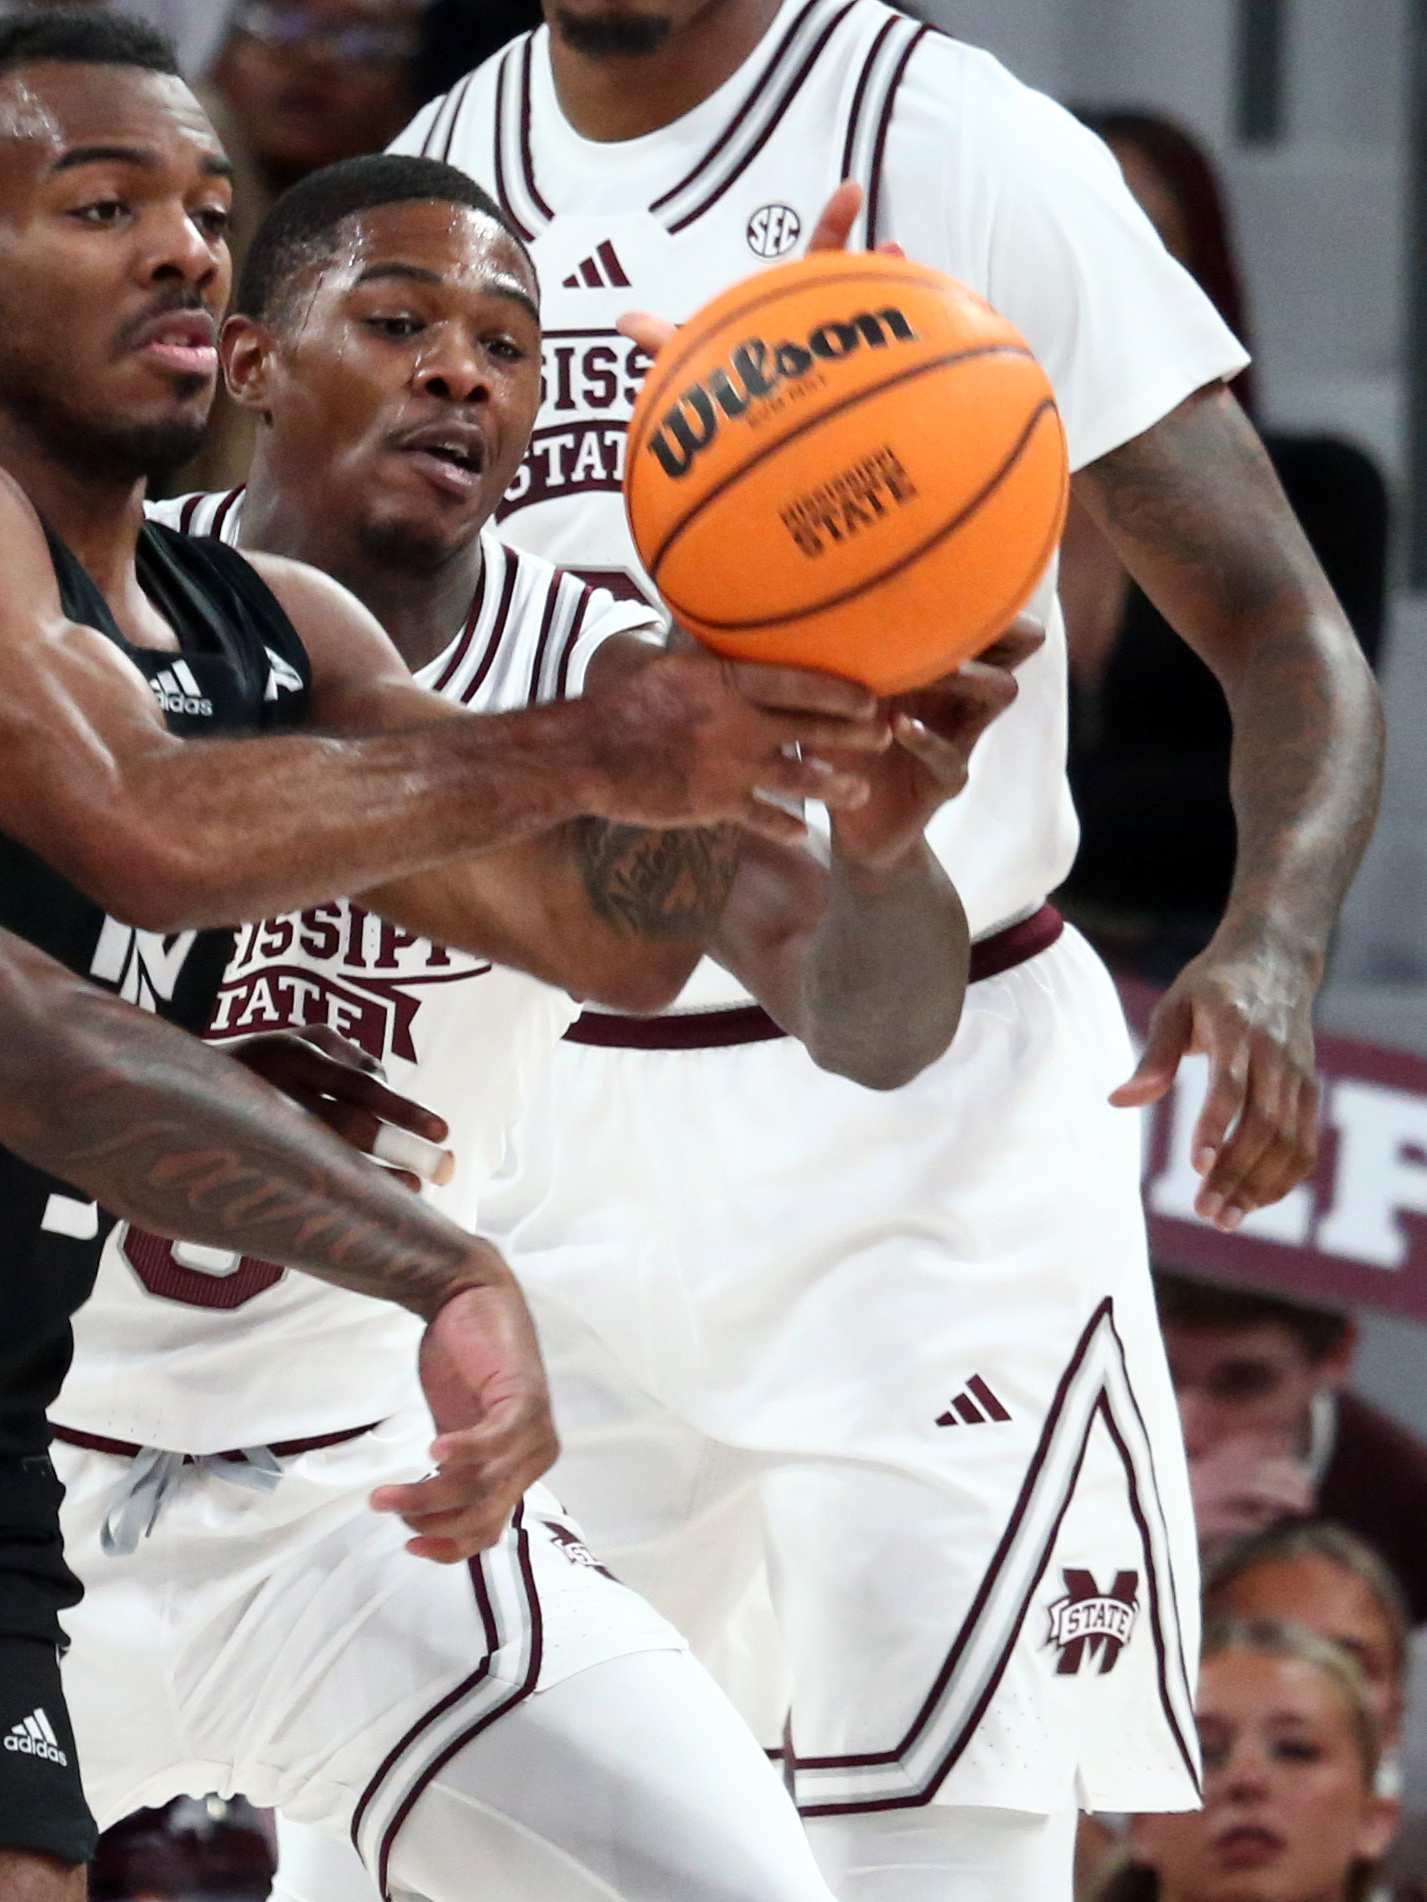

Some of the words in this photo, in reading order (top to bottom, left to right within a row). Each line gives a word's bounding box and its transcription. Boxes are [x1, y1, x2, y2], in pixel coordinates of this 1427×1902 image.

[747, 204, 800, 258] SEC
[540, 347, 656, 410] ISS
[647, 306, 918, 479] Wilson
[1067, 1602, 1131, 1636] STATE
[3, 1734, 68, 1768] adidas
